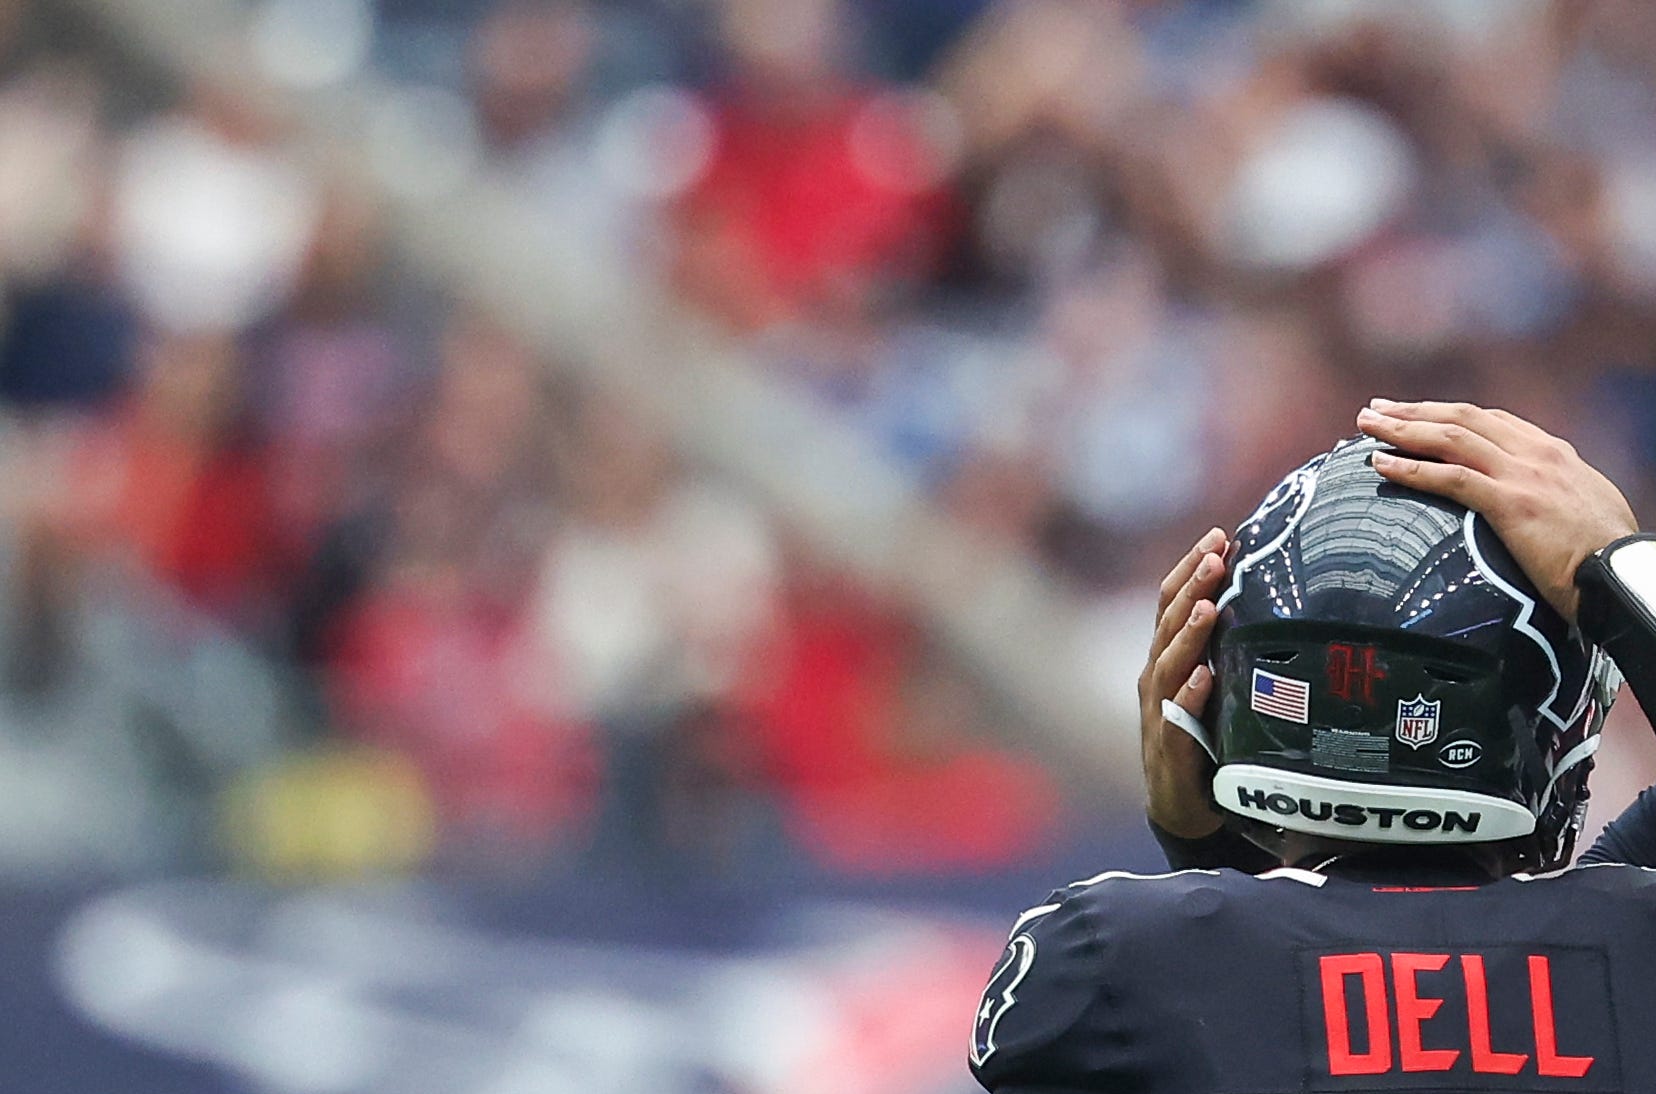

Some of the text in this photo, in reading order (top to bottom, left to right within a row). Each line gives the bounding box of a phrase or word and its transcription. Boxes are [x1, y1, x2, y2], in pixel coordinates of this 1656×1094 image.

[1401, 718, 1432, 741] NFL
[1448, 746, 1474, 761] RCM
[1237, 786, 1481, 832] HOUSTON
[1319, 953, 1594, 1077] DELL
